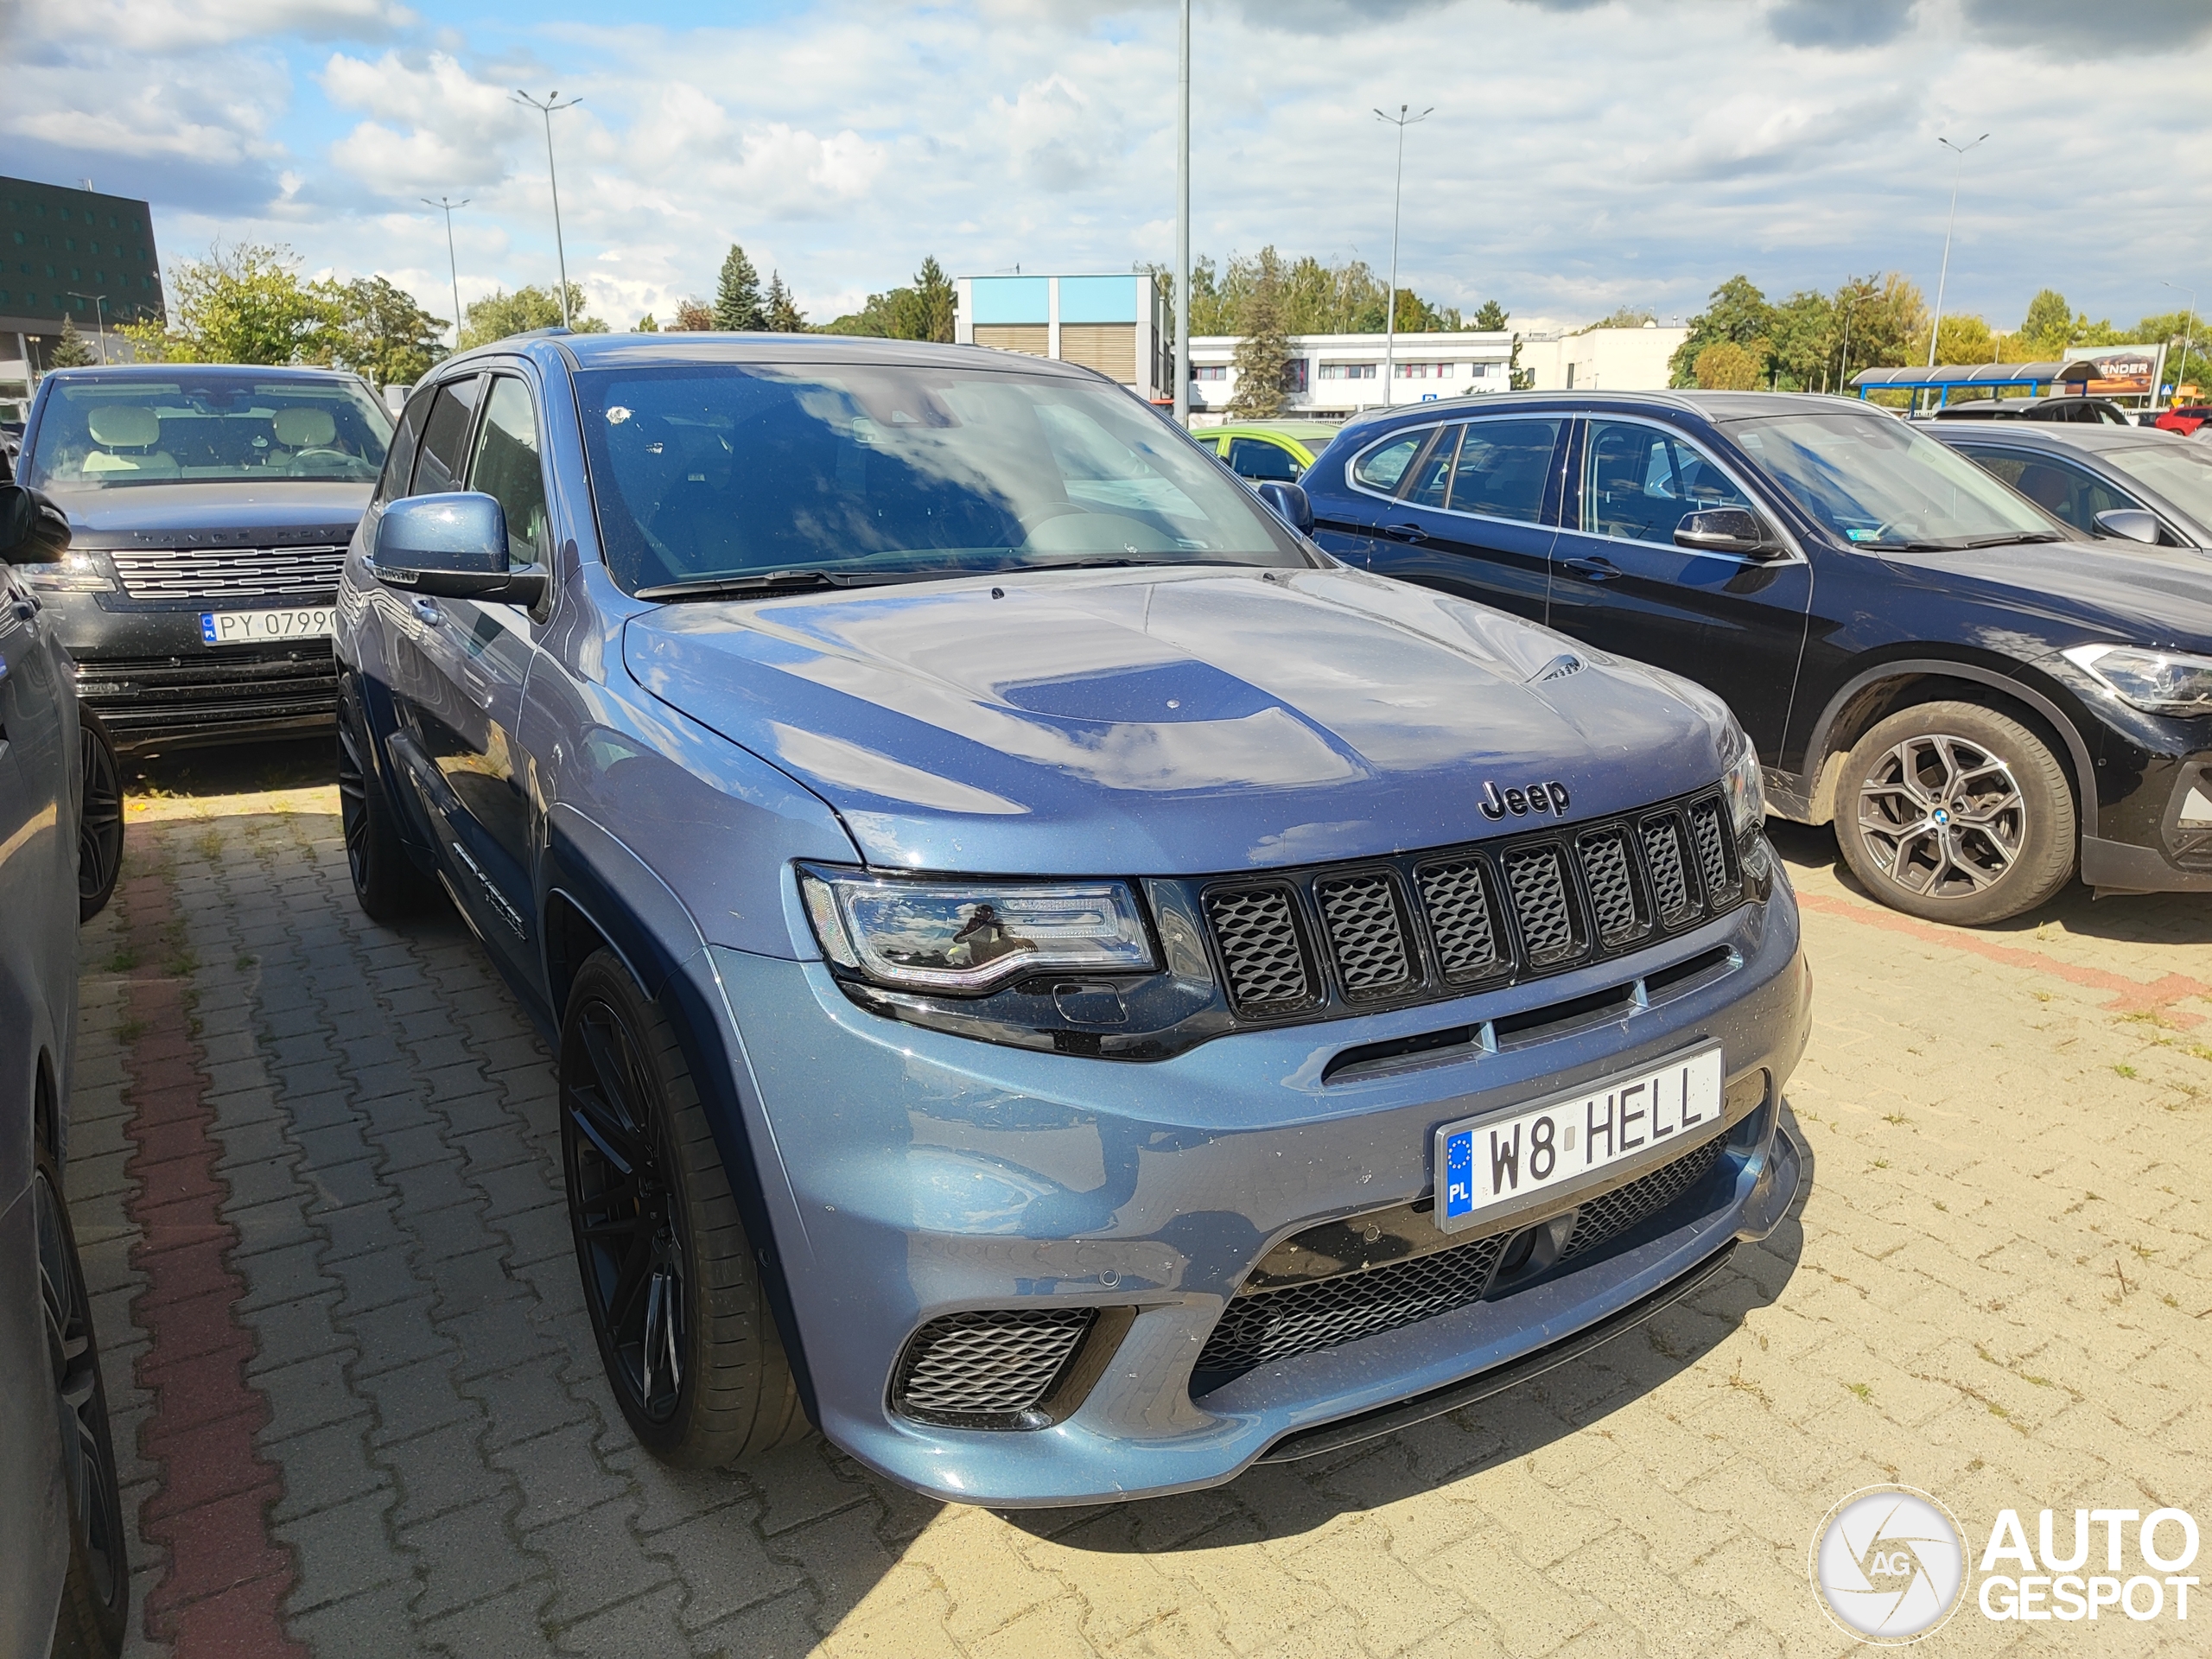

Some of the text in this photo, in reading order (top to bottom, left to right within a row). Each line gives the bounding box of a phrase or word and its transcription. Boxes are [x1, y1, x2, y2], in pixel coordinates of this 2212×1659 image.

[2098, 363, 2148, 375] ENDER
[137, 529, 354, 543] RANGE ROVE
[205, 630, 215, 639] PL
[219, 614, 252, 639] PY
[1476, 780, 1571, 822] Jeep
[1491, 1067, 1702, 1196] W8 HELL
[1449, 1182, 1470, 1204] PL
